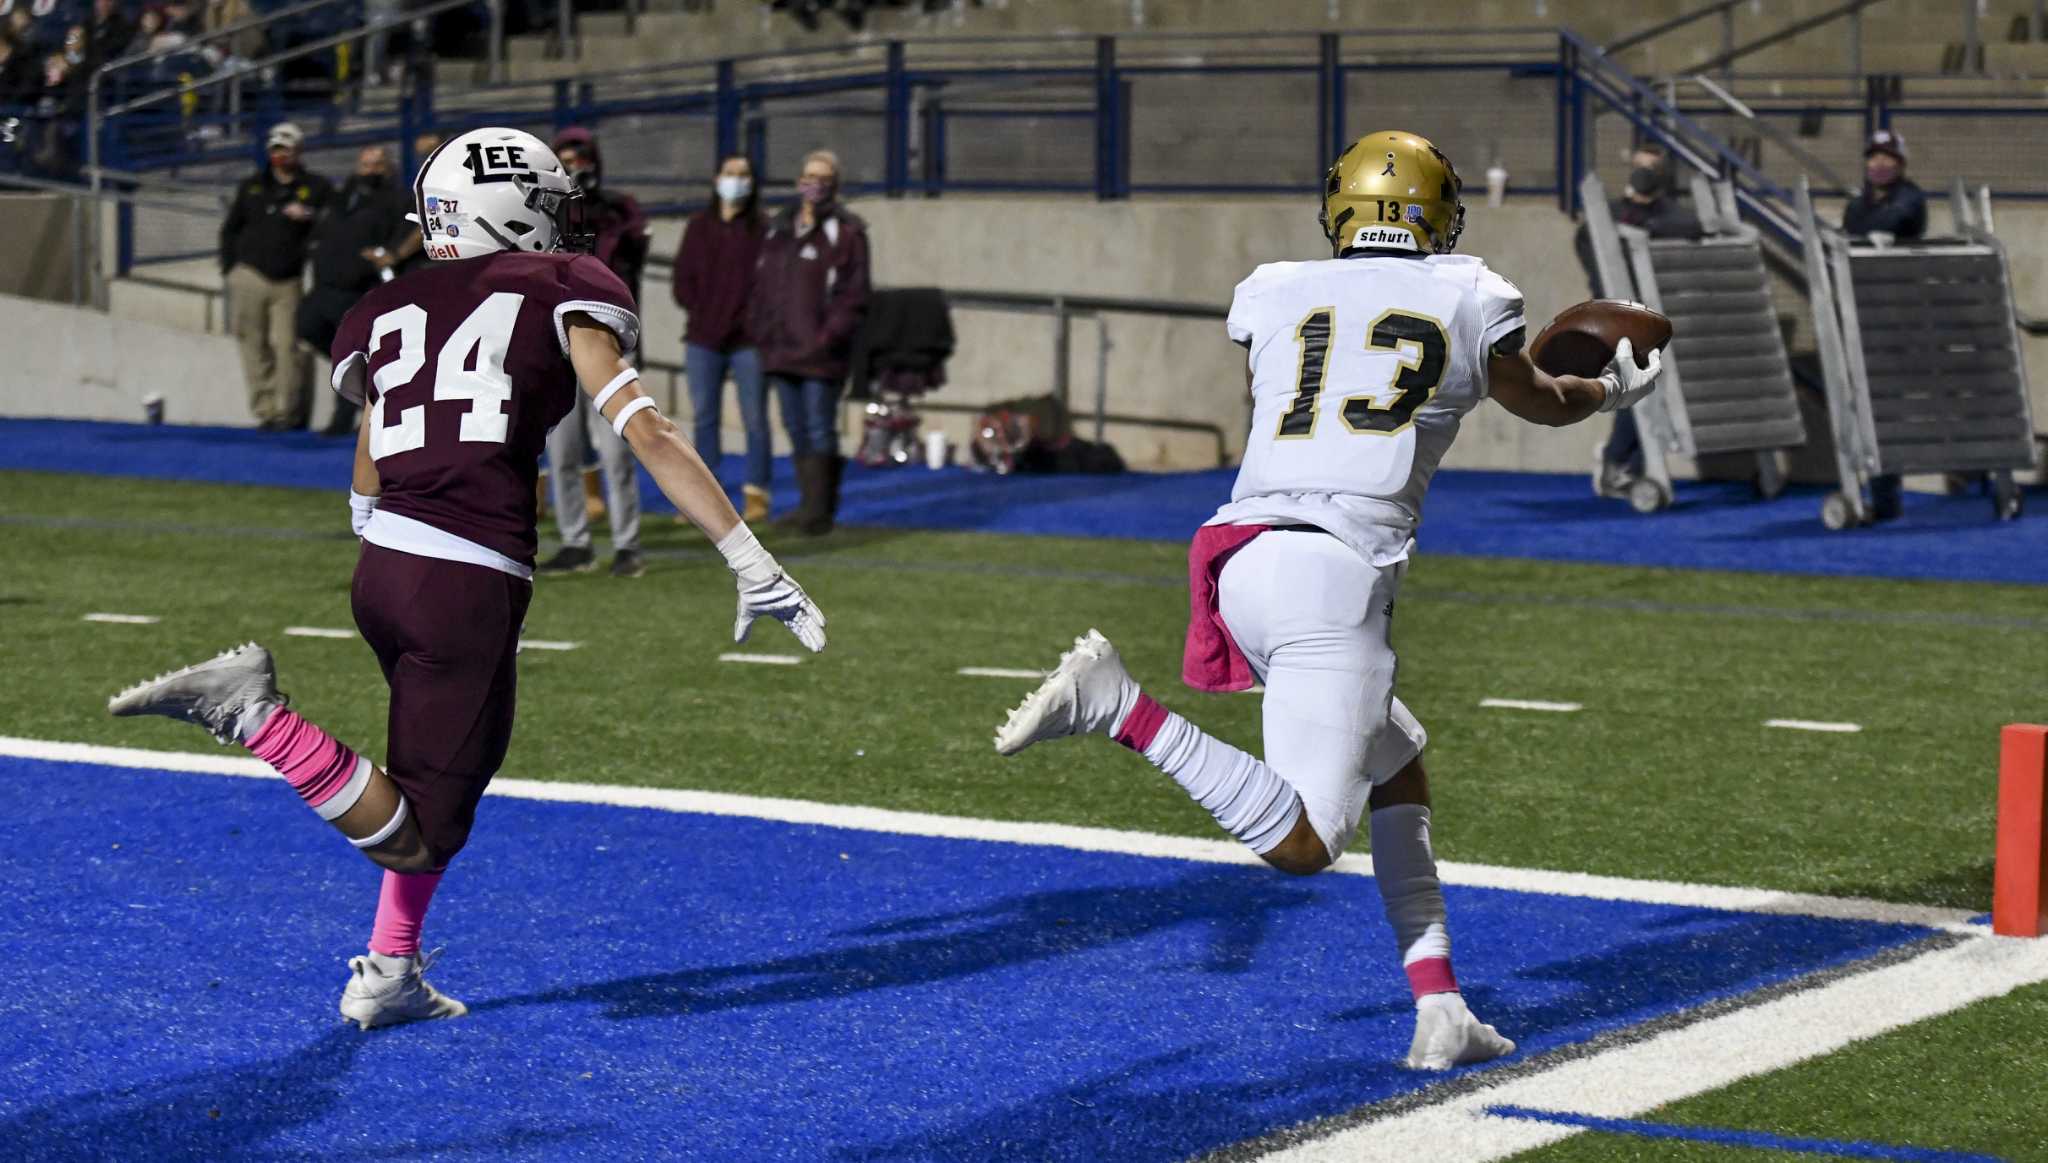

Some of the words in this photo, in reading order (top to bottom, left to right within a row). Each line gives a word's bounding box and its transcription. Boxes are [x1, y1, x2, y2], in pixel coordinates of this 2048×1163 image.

[464, 143, 538, 184] LEE
[1376, 200, 1400, 222] 13
[429, 216, 442, 230] 24
[1360, 230, 1410, 243] schutt
[428, 244, 460, 258] dell
[368, 292, 525, 461] 24
[1274, 306, 1450, 440] 13
